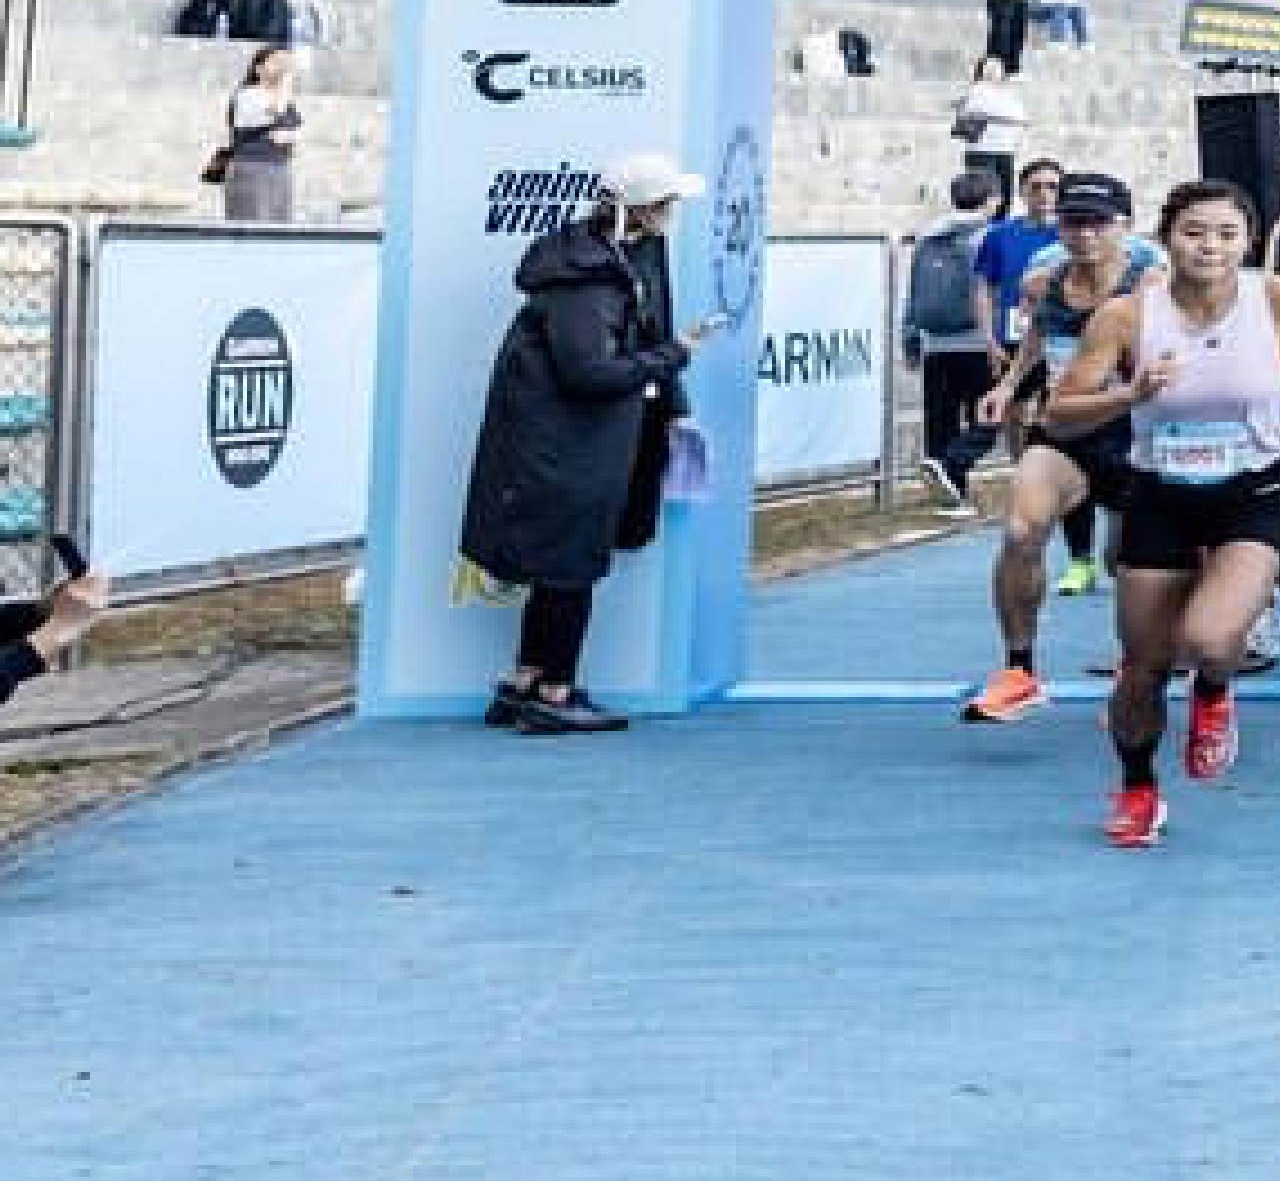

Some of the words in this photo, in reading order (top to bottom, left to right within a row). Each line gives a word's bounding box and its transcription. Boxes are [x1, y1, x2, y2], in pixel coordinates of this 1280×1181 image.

[529, 65, 647, 90] CELSIUS
[757, 328, 872, 386] ARMIN
[215, 371, 287, 431] RUN
